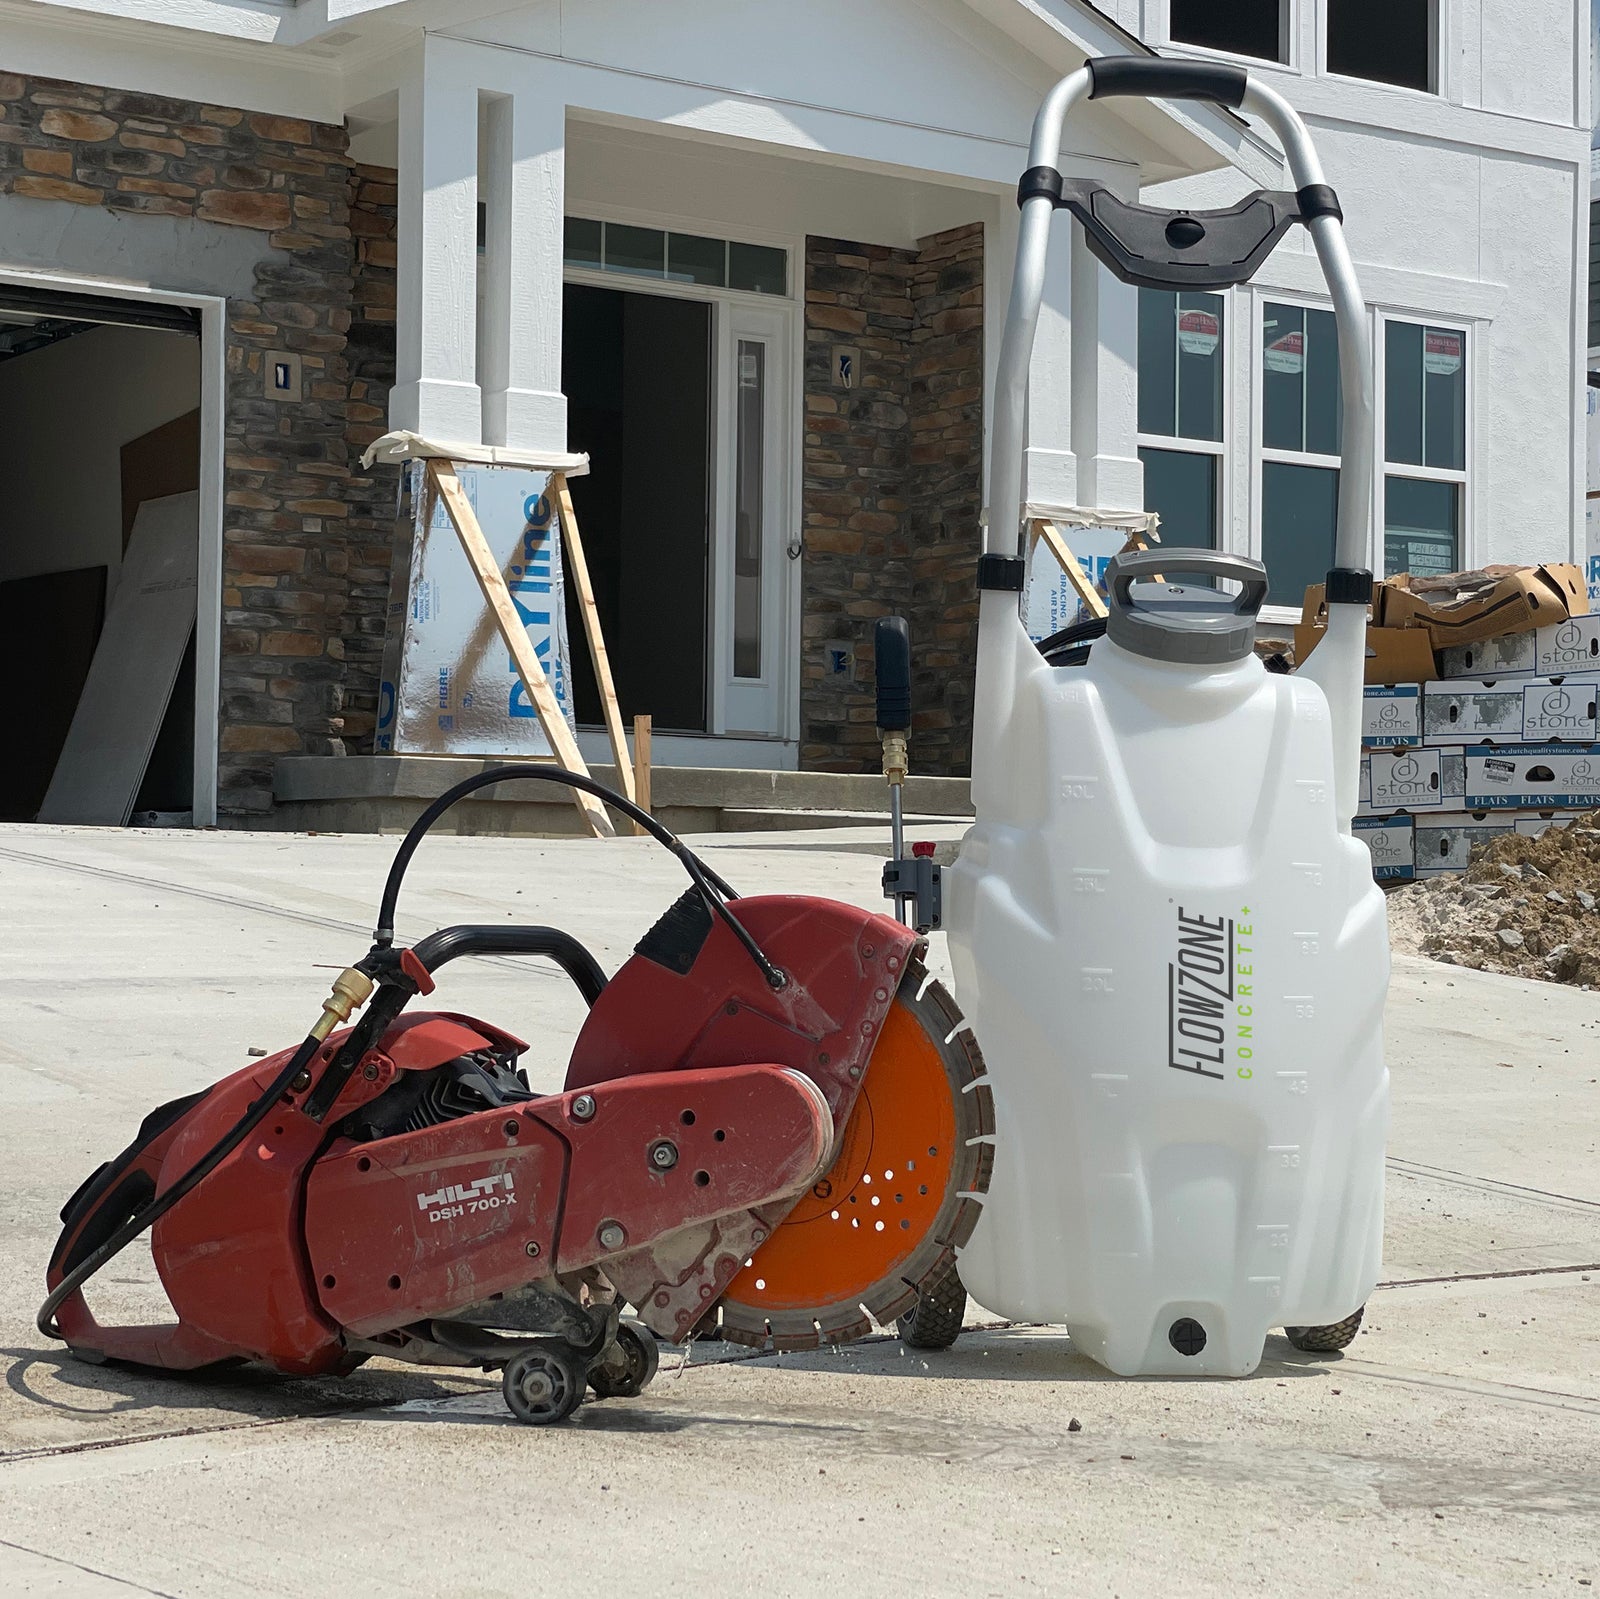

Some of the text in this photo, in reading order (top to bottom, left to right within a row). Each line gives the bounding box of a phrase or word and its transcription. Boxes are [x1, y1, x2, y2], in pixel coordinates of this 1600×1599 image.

[1059, 574, 1067, 618] BRACING
[1050, 608, 1058, 635] BARR
[439, 667, 448, 709] FIBRE
[1370, 718, 1411, 729] stone
[1526, 712, 1591, 729] stone
[1376, 737, 1410, 745] FLATS
[1474, 796, 1508, 805] FLATS
[1521, 795, 1555, 804] FLATS
[1567, 795, 1600, 804] FLATS
[1371, 846, 1401, 858] one
[1374, 866, 1401, 876] LATS
[1169, 906, 1234, 1081] FLOWZONE
[417, 1172, 514, 1210] HILTI
[429, 1192, 517, 1223] DSH 700-X
